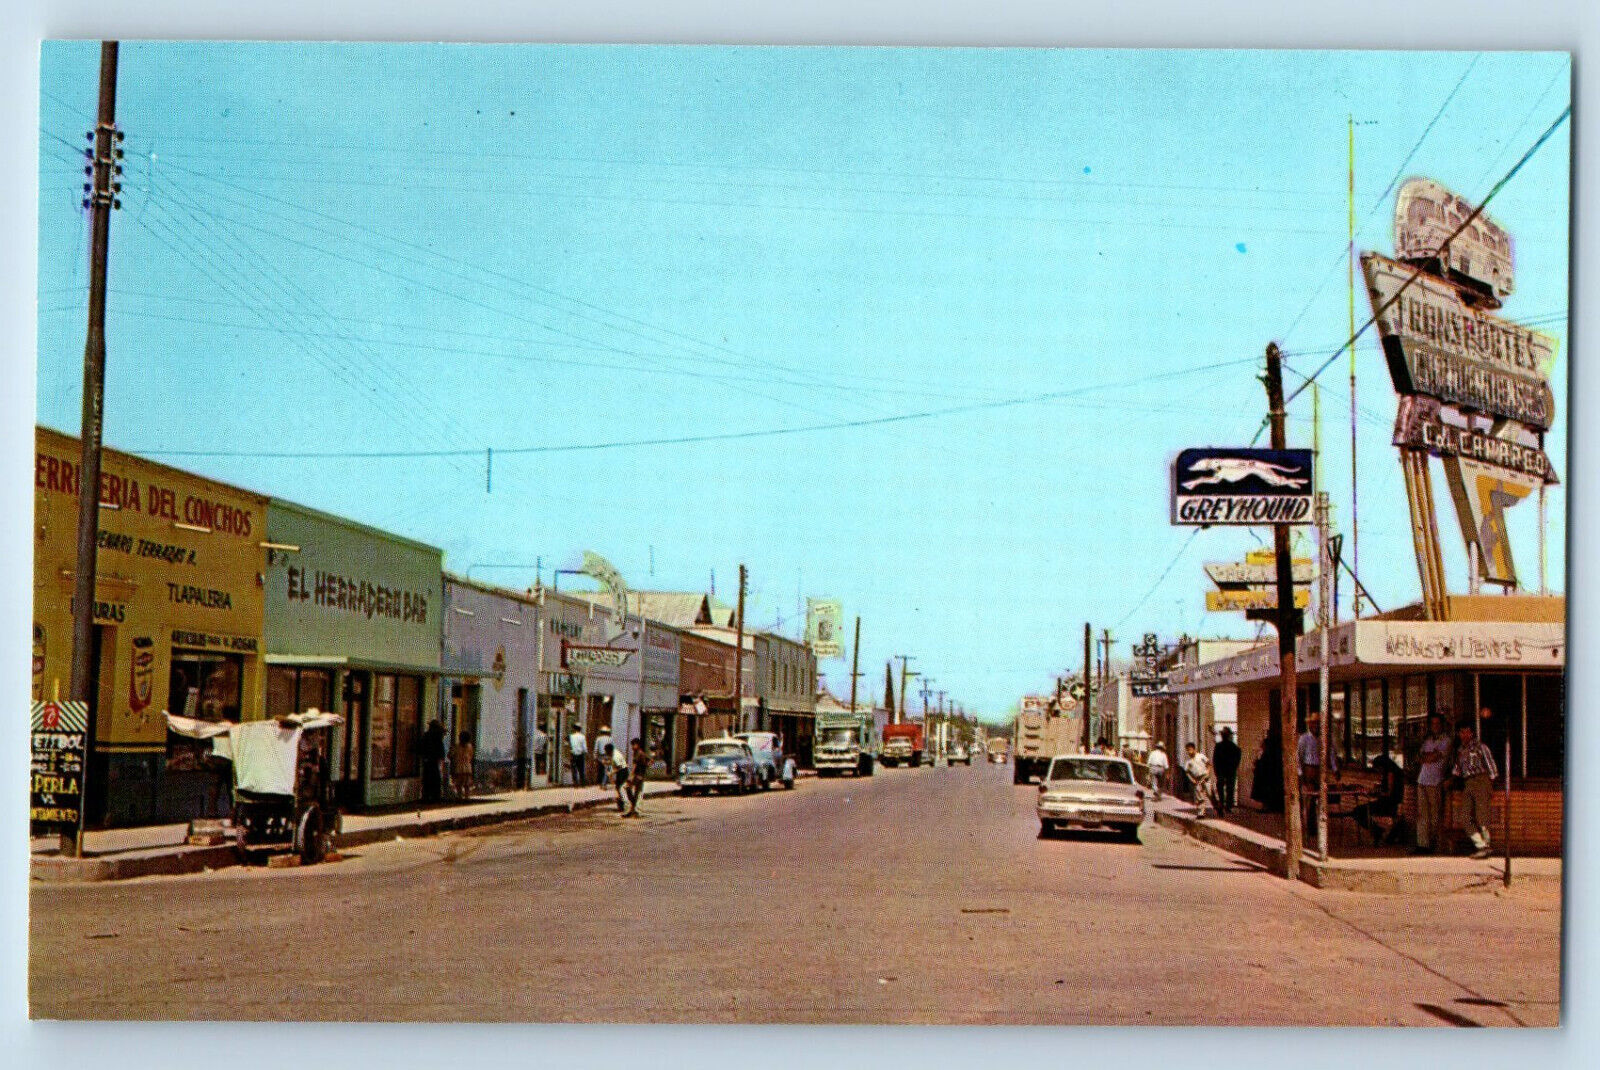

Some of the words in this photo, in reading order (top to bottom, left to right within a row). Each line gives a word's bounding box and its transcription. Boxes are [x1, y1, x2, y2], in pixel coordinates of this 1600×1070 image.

[148, 485, 179, 521] DEL
[184, 495, 252, 537] CONCHOS
[1180, 498, 1310, 521] GREYHOUND
[167, 582, 233, 611] TLAPALERIA
[288, 565, 310, 602] EL
[403, 589, 427, 624] BAR
